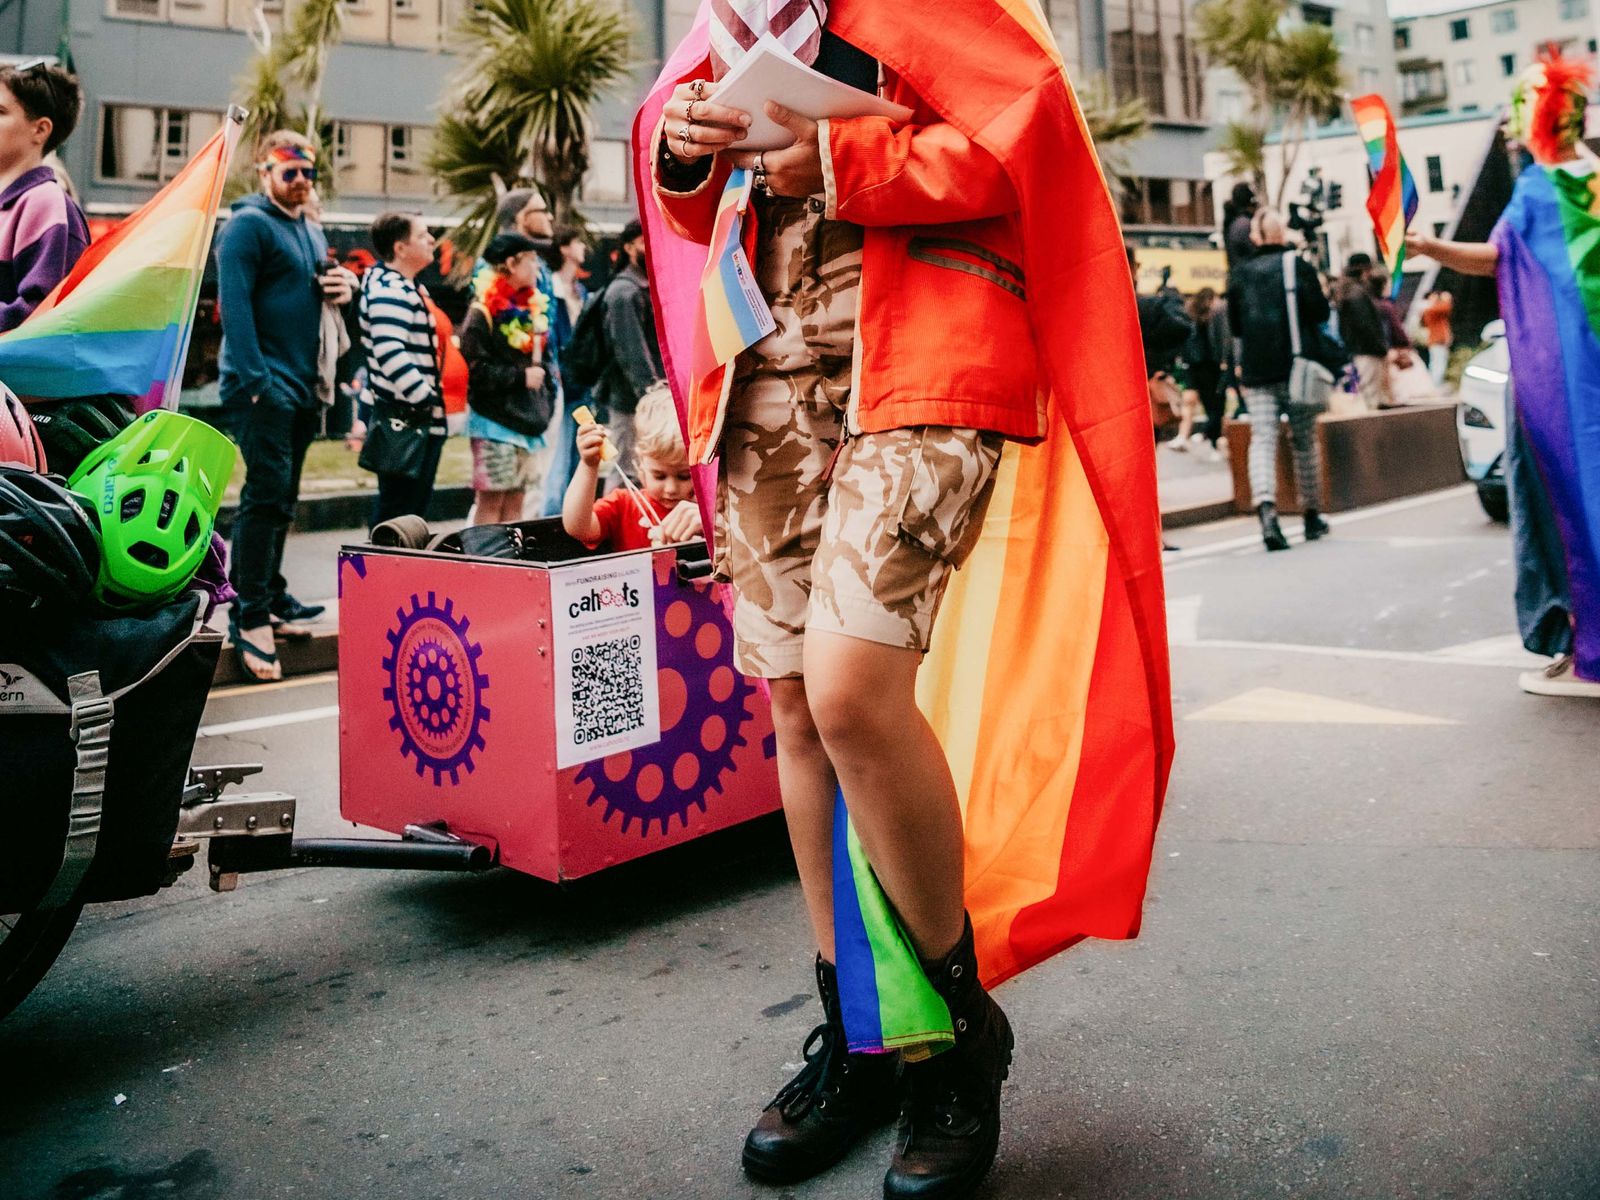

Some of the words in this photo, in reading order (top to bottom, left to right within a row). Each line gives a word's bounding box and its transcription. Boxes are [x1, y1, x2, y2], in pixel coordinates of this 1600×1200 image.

[103, 475, 116, 514] GIRO
[576, 572, 618, 585] FUNDRAISING
[568, 582, 640, 619] cahoots
[0, 691, 25, 702] ern
